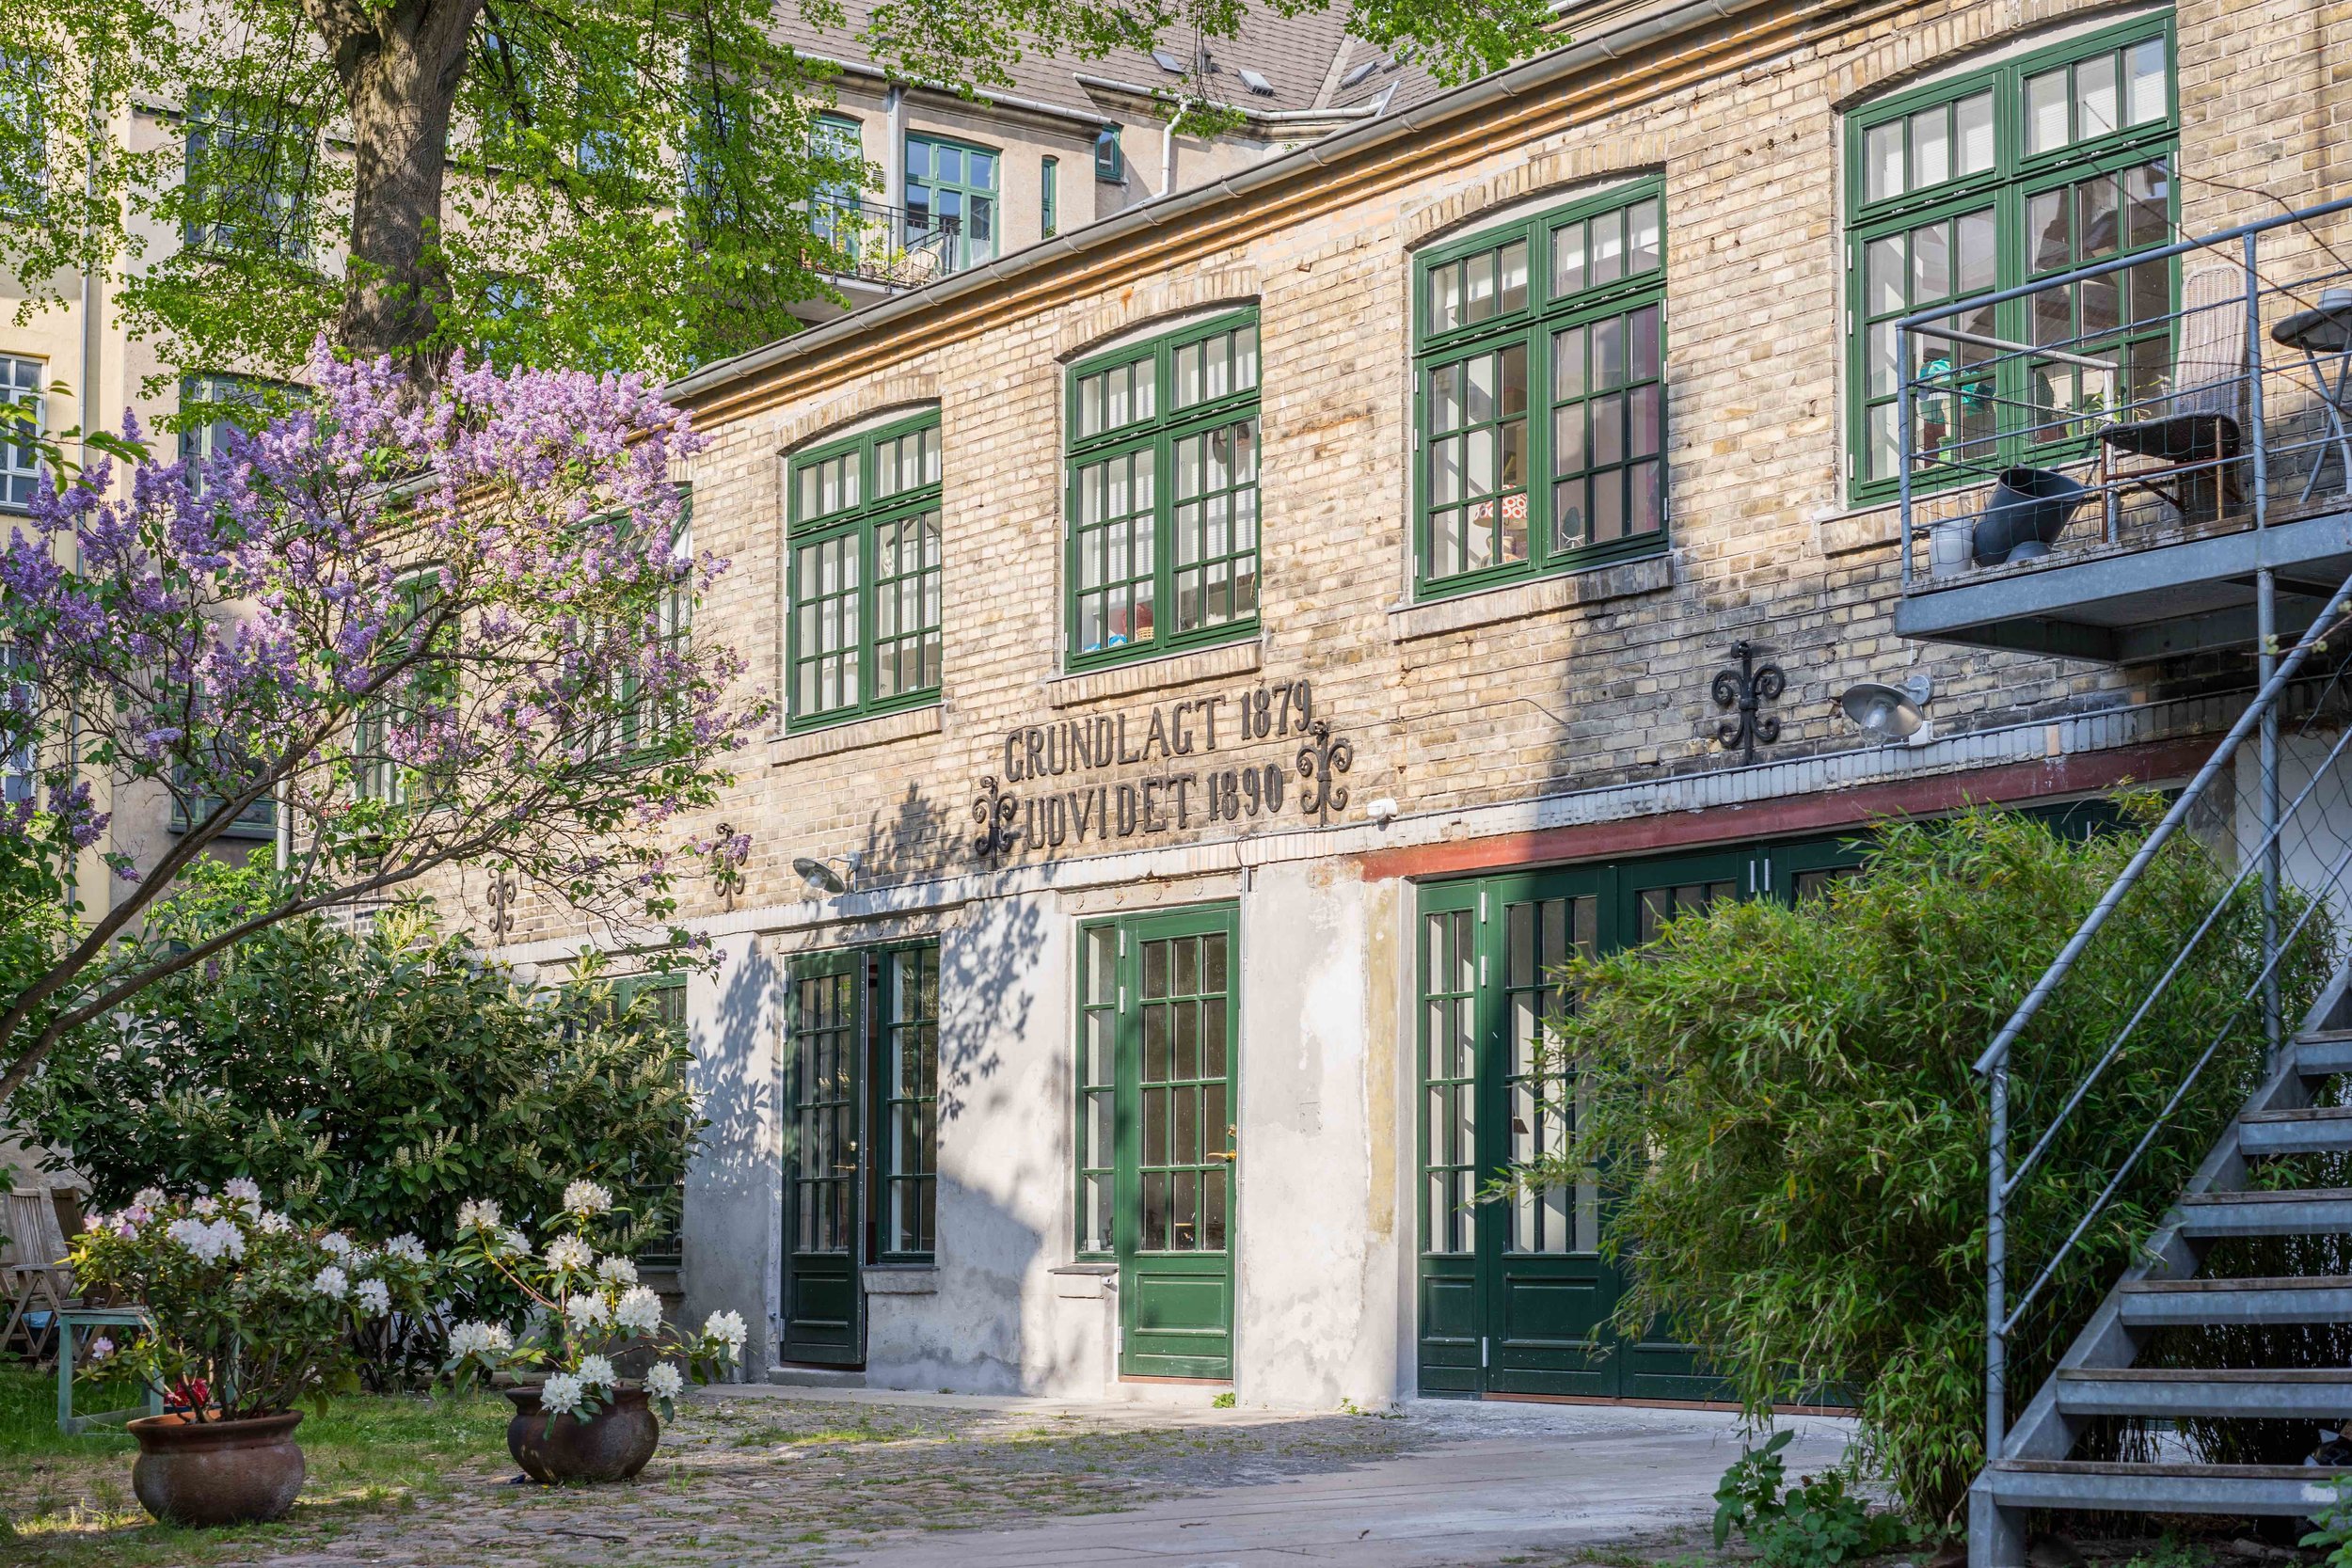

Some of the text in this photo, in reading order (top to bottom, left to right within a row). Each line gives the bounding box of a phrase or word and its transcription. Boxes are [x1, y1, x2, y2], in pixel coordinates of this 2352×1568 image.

[1005, 679, 1312, 782] GRUNDLAGT 1879
[1025, 763, 1284, 849] UDVIDET 1890
